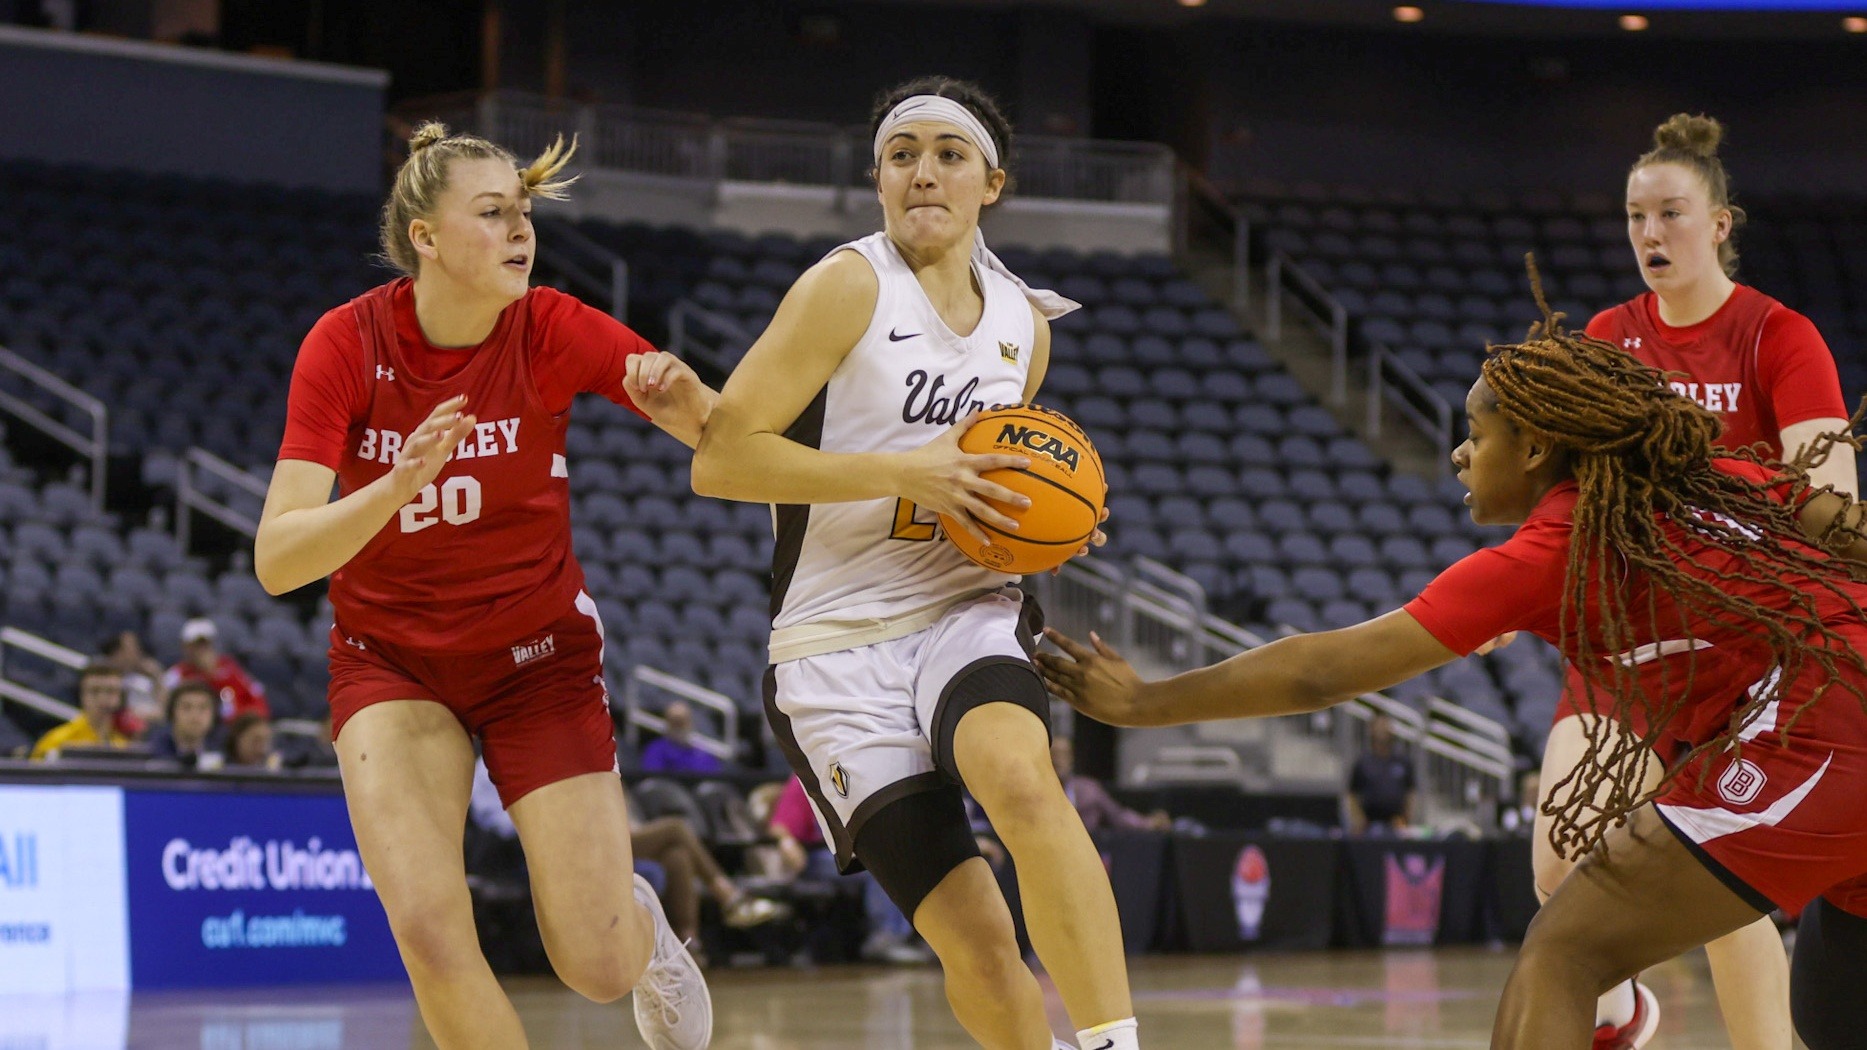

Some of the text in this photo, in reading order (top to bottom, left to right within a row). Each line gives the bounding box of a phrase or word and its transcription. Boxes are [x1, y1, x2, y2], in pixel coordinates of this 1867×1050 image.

[357, 417, 521, 465] BRLEY
[996, 423, 1080, 474] NCAA
[400, 476, 482, 533] 20
[511, 634, 555, 664] VALLEY
[161, 837, 265, 891] Credit
